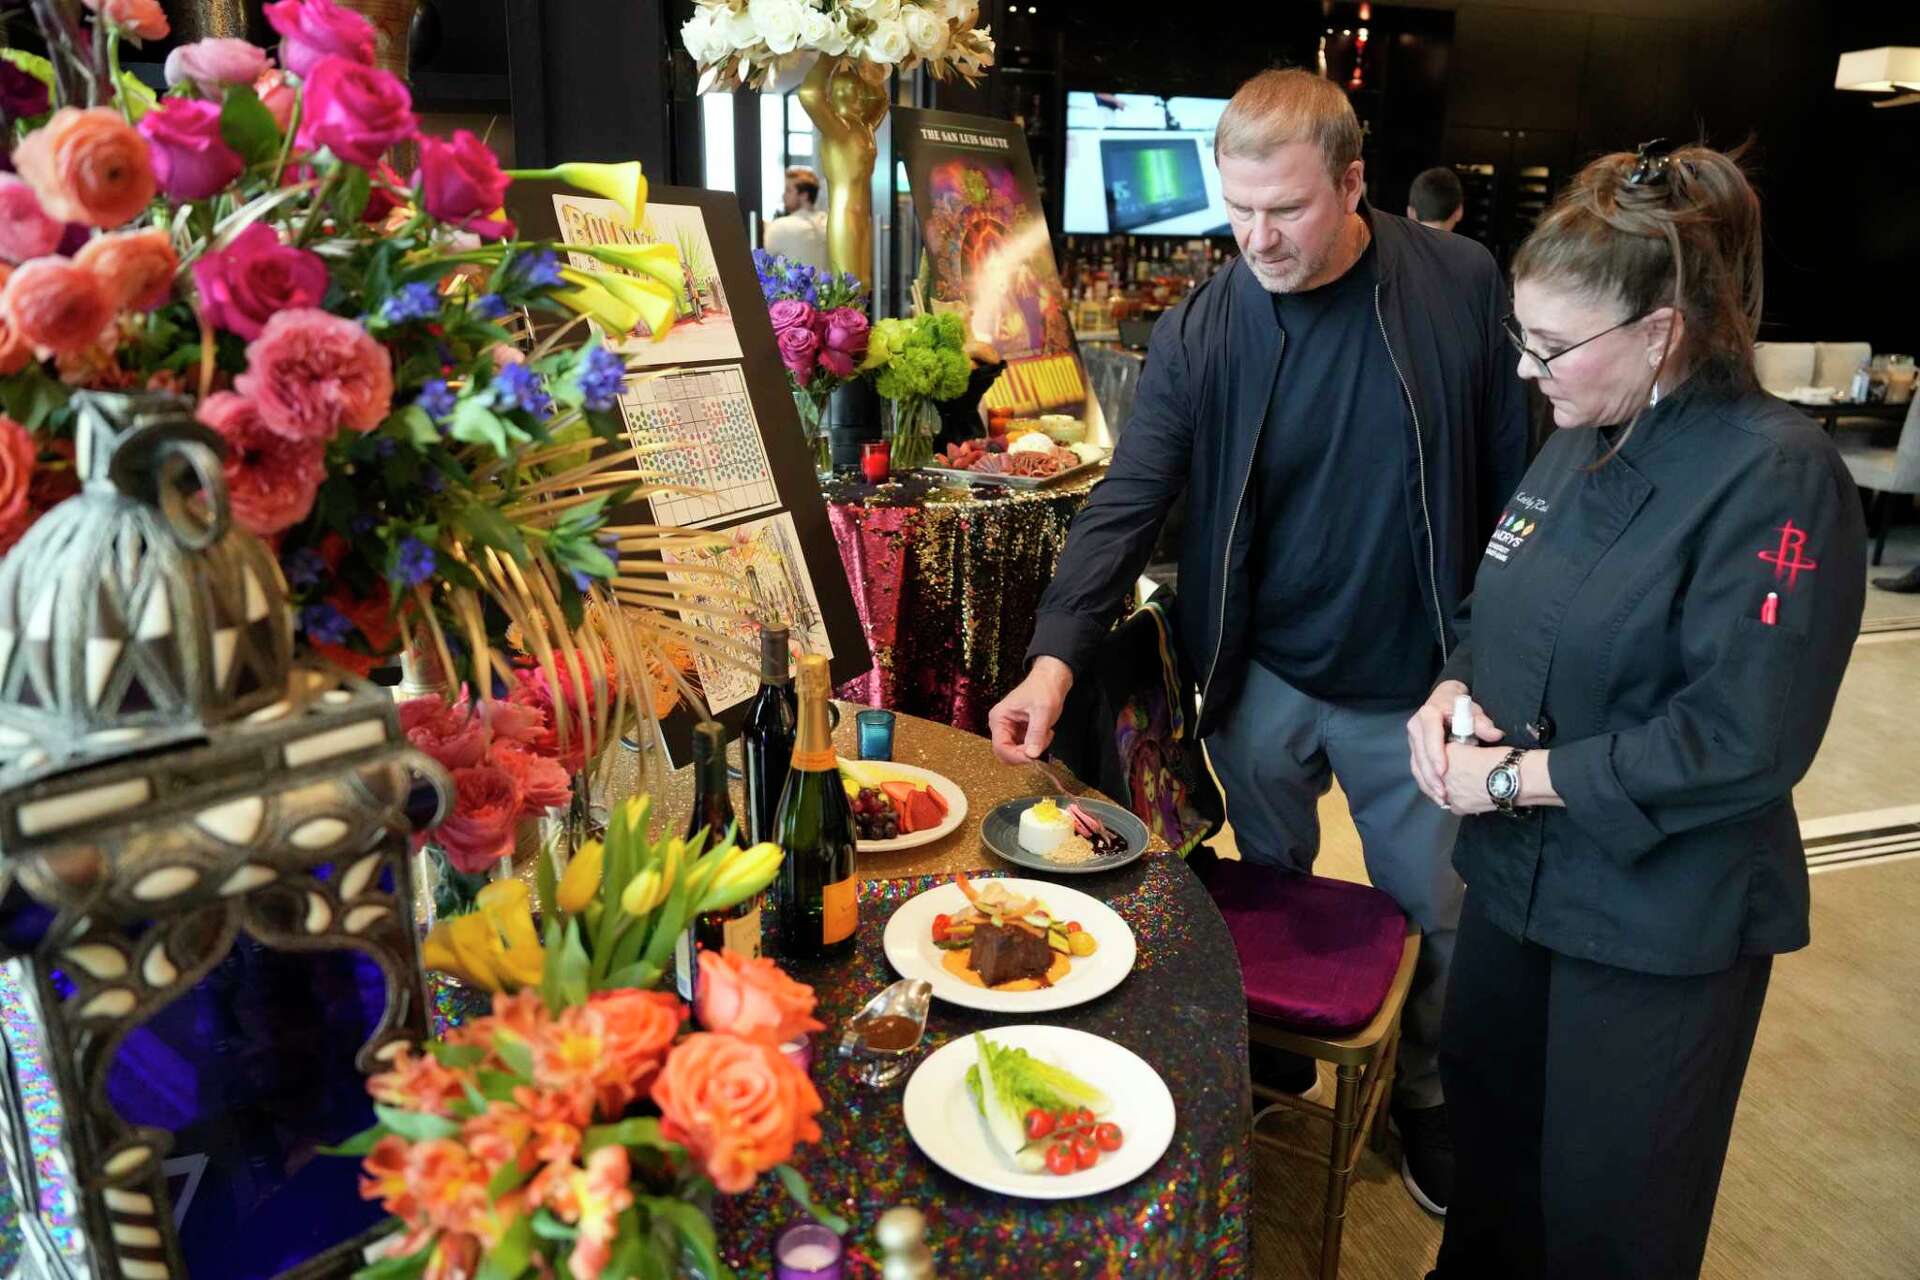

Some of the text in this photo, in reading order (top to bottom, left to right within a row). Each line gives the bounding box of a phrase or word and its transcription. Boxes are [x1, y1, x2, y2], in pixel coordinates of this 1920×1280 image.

[920, 128, 1009, 149] THE SAN LUIS SALUTE
